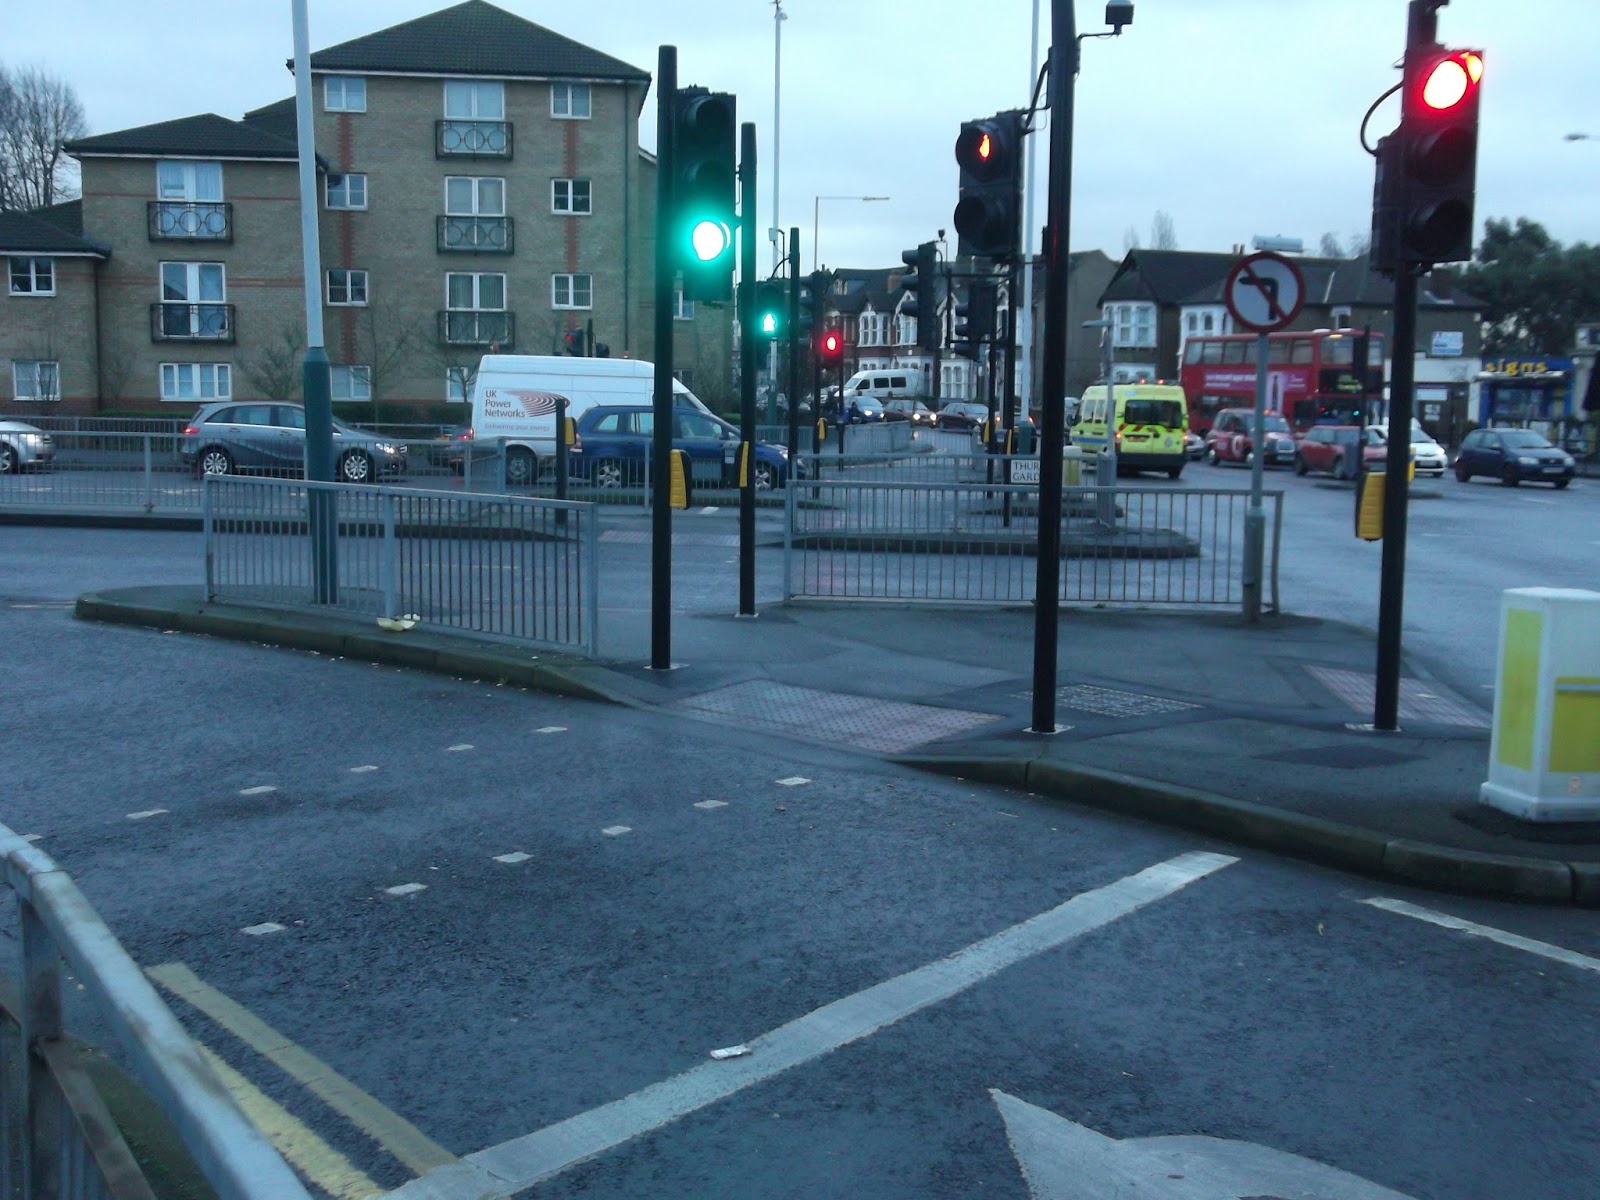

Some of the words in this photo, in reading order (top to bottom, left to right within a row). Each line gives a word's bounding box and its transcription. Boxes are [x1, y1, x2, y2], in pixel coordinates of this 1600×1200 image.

[1486, 359, 1547, 376] signs
[485, 389, 497, 398] UK
[485, 399, 512, 408] Power
[484, 408, 526, 418] Networks
[1013, 461, 1040, 470] THUR
